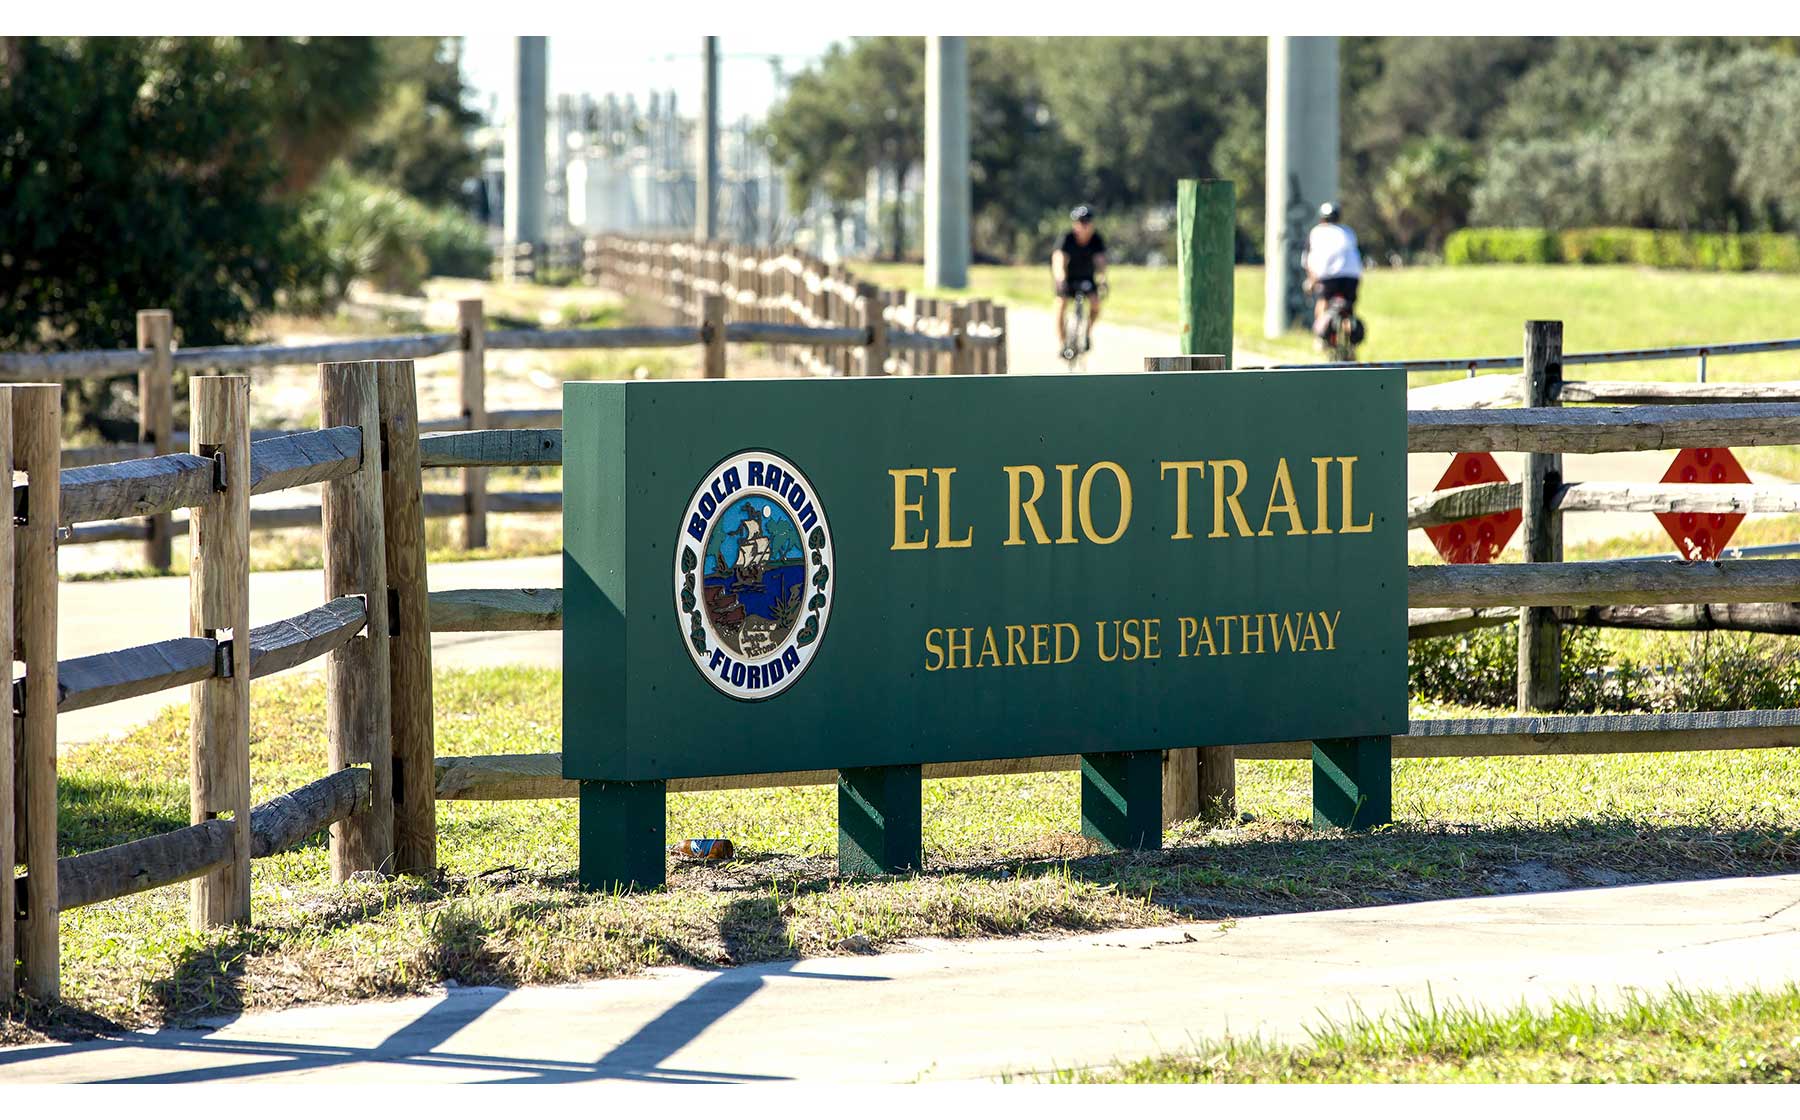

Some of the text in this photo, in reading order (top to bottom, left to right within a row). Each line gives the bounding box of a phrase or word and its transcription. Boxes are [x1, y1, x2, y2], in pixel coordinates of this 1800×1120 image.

[687, 461, 818, 543] BOCA RATON
[888, 455, 1374, 551] EL RIO TRAIL
[709, 644, 801, 690] FLORIDA
[925, 610, 1341, 671] SHARED USE PATHWAY
